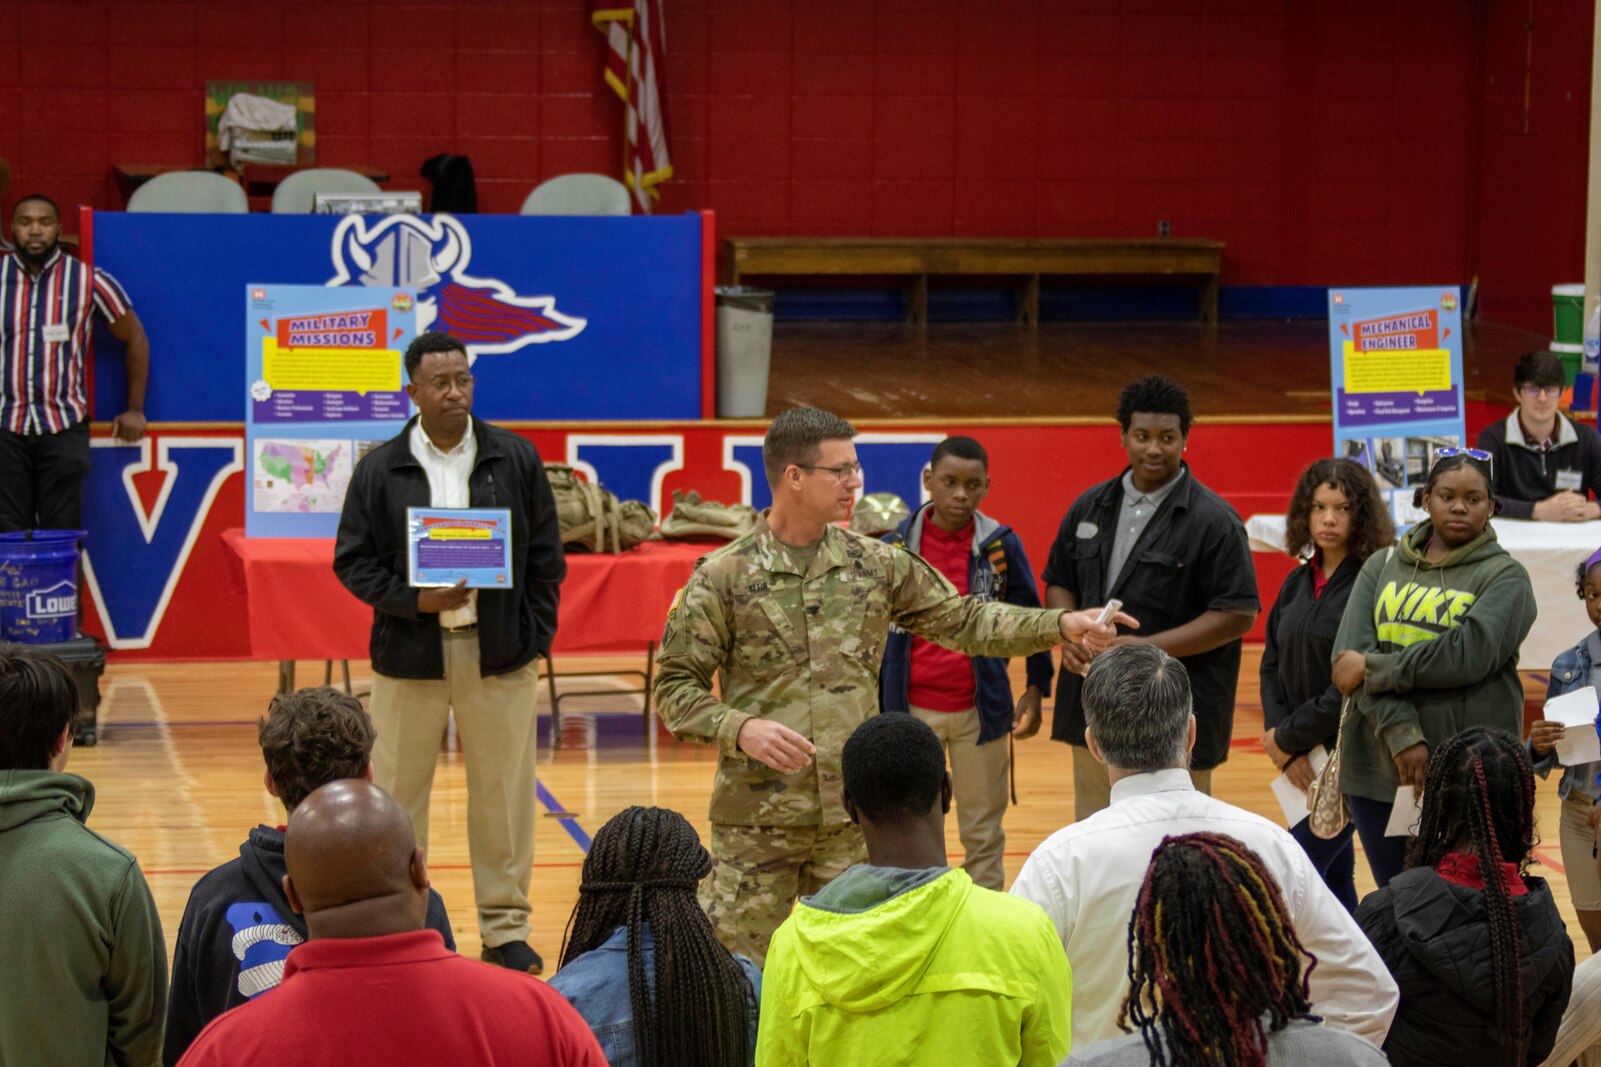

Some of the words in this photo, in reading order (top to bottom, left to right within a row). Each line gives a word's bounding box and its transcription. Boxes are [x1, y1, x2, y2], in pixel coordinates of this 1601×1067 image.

[289, 313, 373, 331] MILITARY
[1361, 314, 1432, 335] MECHANICAL
[289, 332, 376, 346] MISSIONS
[1361, 335, 1418, 350] ENGINEER
[1375, 581, 1476, 628] NIKE
